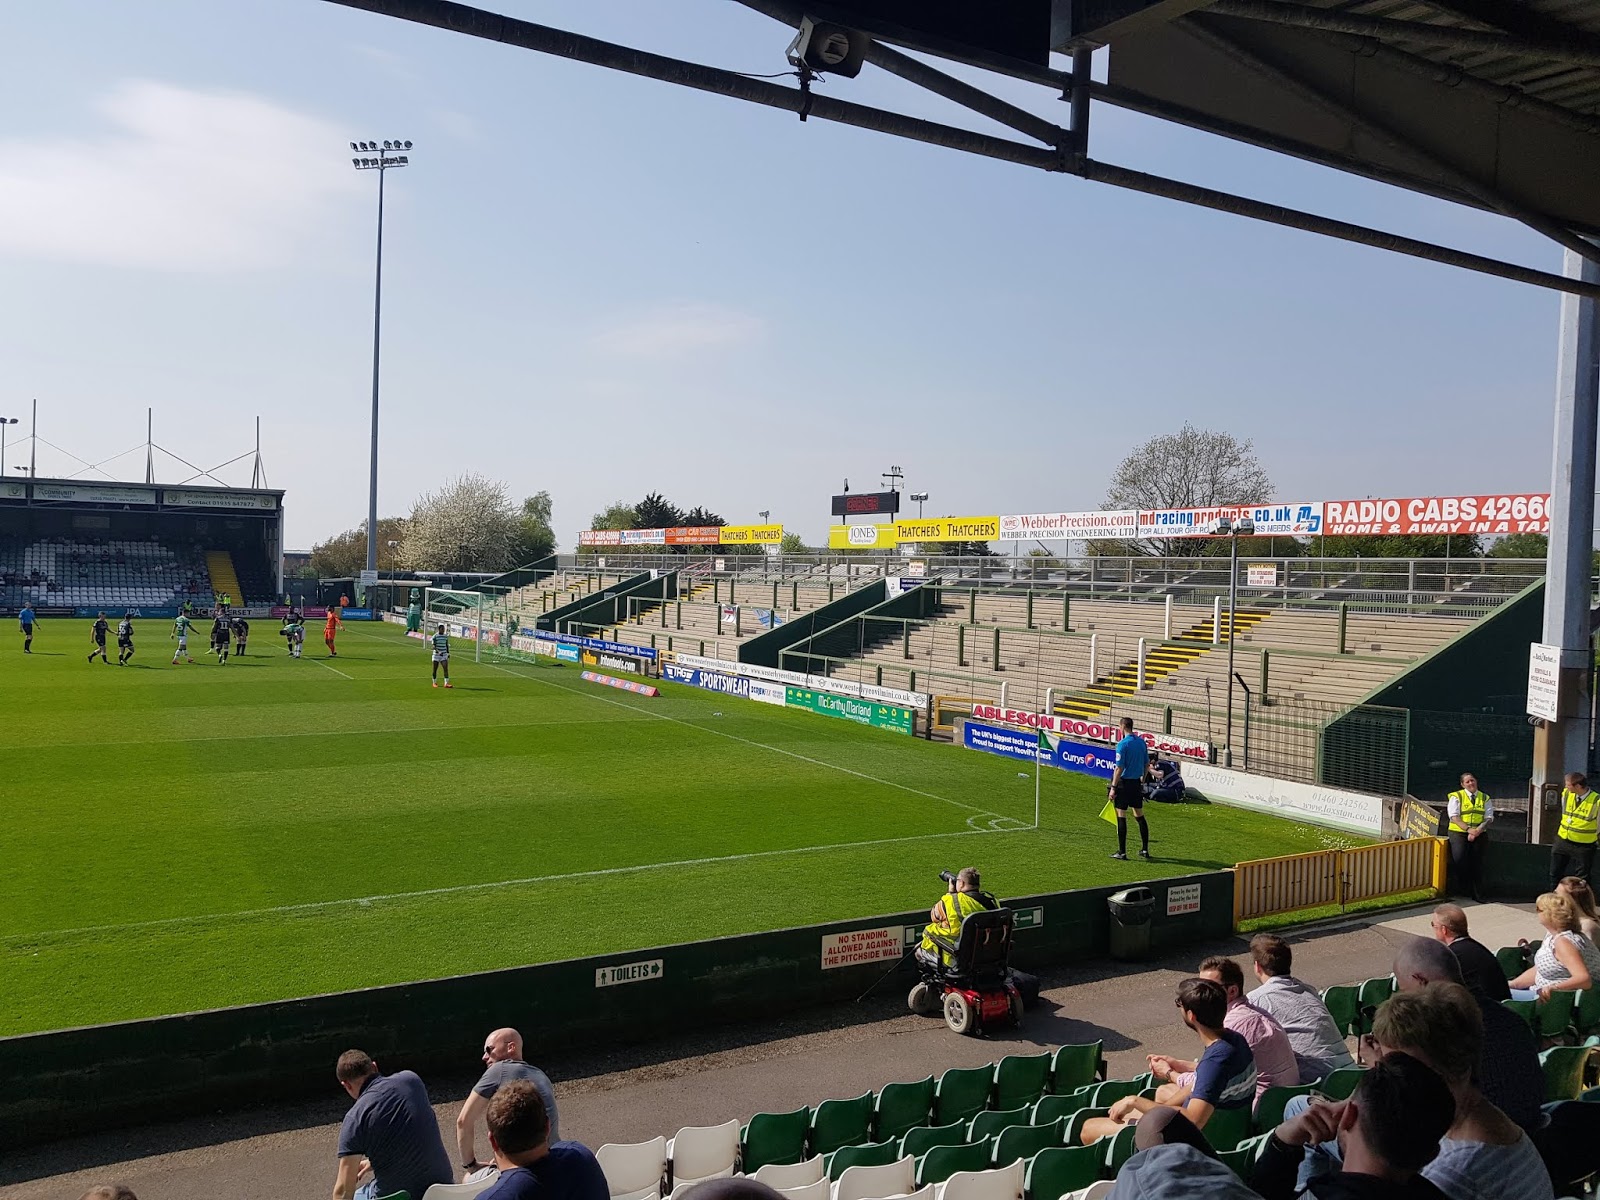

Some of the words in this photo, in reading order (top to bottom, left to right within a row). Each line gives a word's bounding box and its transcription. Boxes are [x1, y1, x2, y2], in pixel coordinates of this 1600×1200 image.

[1327, 500, 1401, 523] RADIO
[1407, 498, 1477, 522] CABS
[1021, 513, 1134, 529] WebberPrecision.com
[1140, 527, 1152, 535] FOR
[1153, 527, 1165, 535] ALL
[1185, 526, 1198, 534] OFF
[1267, 524, 1291, 533] NEEDS
[1387, 523, 1401, 534] &
[1407, 521, 1463, 534] AWAY
[1468, 521, 1491, 533] IN
[1494, 521, 1509, 533] A
[1516, 520, 1550, 532] TAX
[688, 528, 699, 536] CAR
[722, 530, 748, 540] THATCHERS
[752, 529, 780, 540] THATCHERS
[851, 527, 876, 540] JONES
[897, 524, 941, 538] THATCHERS
[947, 522, 996, 537] THATCHERS
[1001, 530, 1027, 539] WEBBER
[1029, 529, 1064, 538] PRECISION
[1066, 528, 1116, 538] ENGINEERING
[1119, 527, 1135, 537] LTD
[220, 621, 228, 630] 11
[600, 653, 636, 672] tritontools.com
[699, 671, 749, 696] SPORTSWEAR
[818, 695, 846, 714] McCarthy
[846, 700, 872, 717] Marland
[973, 705, 1054, 729] ABLESON
[971, 729, 980, 737] The
[981, 731, 993, 739] UK's
[993, 733, 1012, 744] biggest
[1012, 737, 1024, 747] tech
[972, 737, 988, 747] Proud
[994, 743, 1014, 752] support
[1014, 746, 1035, 757] Yeovil's
[1062, 751, 1085, 765] Currys
[1187, 764, 1235, 787] Loxston
[1312, 792, 1337, 805] 01460
[1339, 798, 1369, 811] 242562
[1302, 800, 1379, 824] www.loxston.co.uk
[838, 936, 849, 944] NO
[852, 930, 888, 942] STANDING
[828, 944, 863, 955] ALLOWED
[866, 938, 897, 950] AGAINST
[824, 956, 839, 965] THE
[841, 950, 880, 963] PITCHSIDE
[882, 948, 901, 957] WALL
[611, 964, 649, 981] TOILETS
